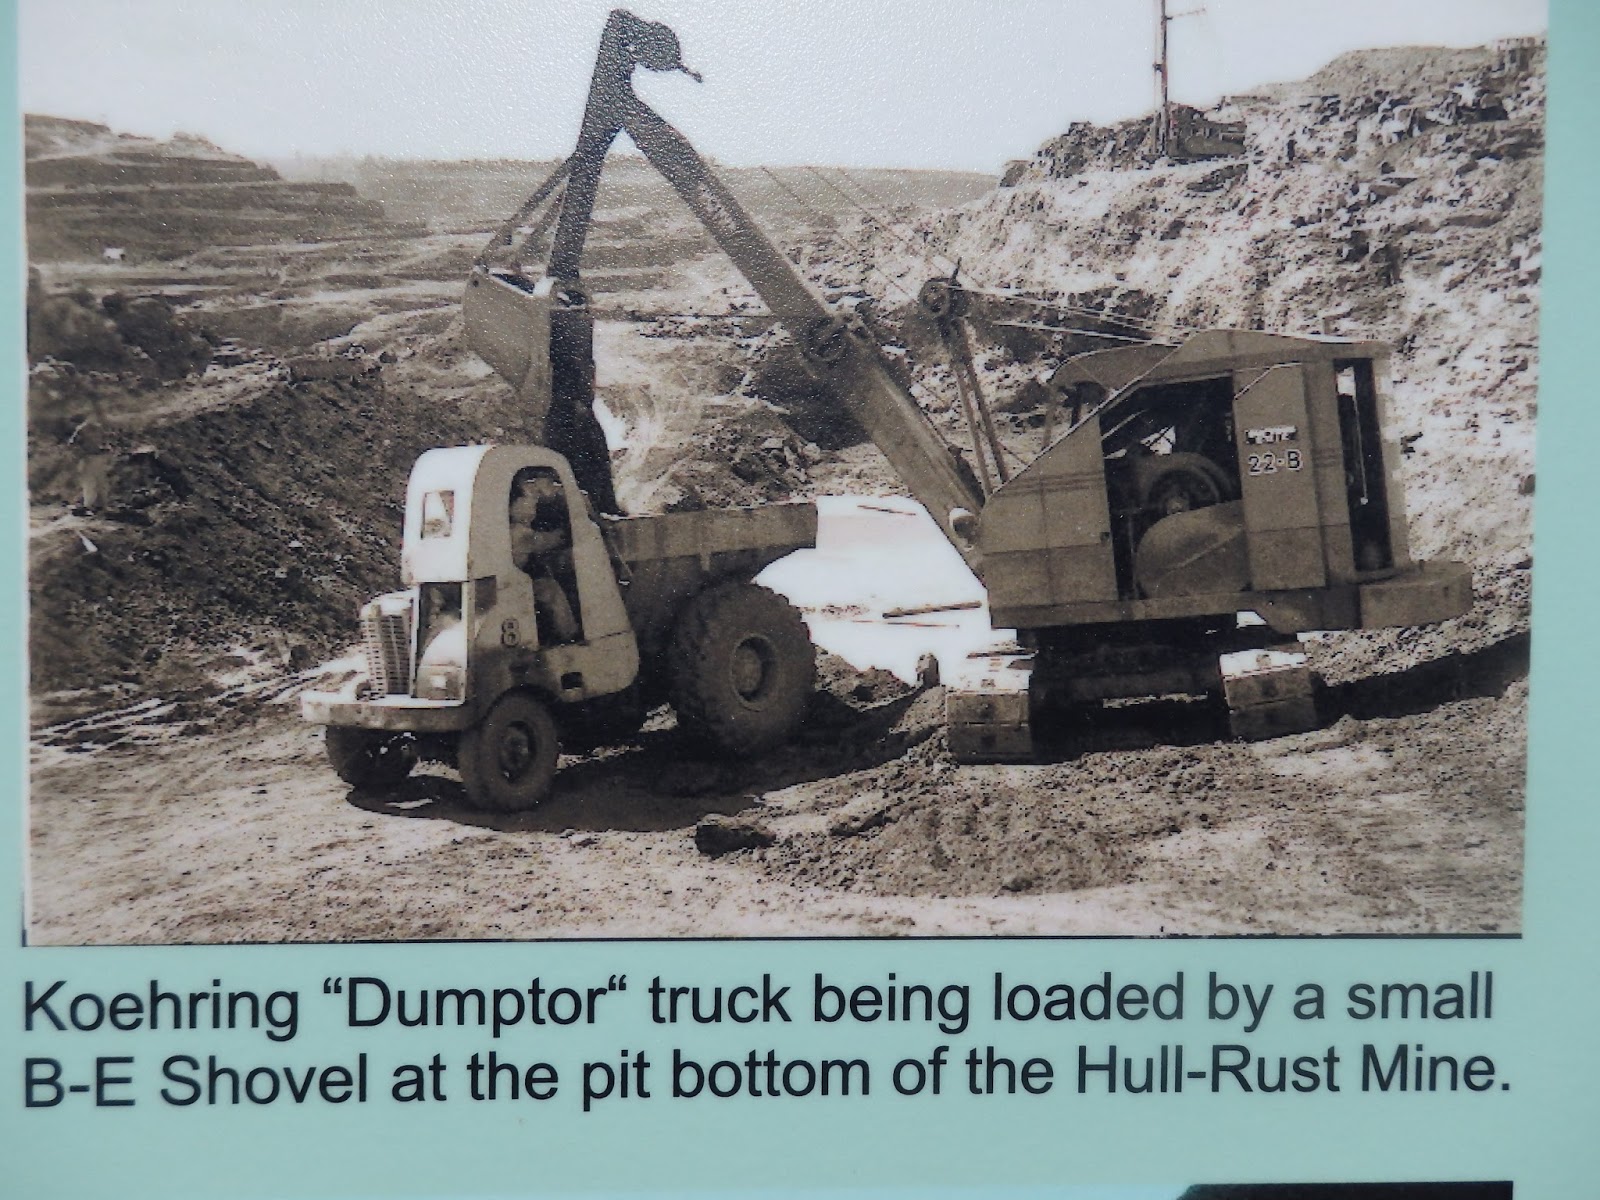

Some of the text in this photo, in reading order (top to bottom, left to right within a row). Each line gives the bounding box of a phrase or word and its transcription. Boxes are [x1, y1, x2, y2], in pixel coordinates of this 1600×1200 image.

[1248, 449, 1303, 476] 22-B
[24, 979, 299, 1042] Koehring
[647, 974, 793, 1025] truck
[814, 973, 970, 1034] being
[994, 972, 1184, 1022] loaded
[1208, 972, 1274, 1032] by
[1293, 983, 1325, 1021] a
[1346, 971, 1494, 1021] small
[24, 1043, 1511, 1112] B-E Shovel at the pit bottom of the Hull-Rust Mine.
